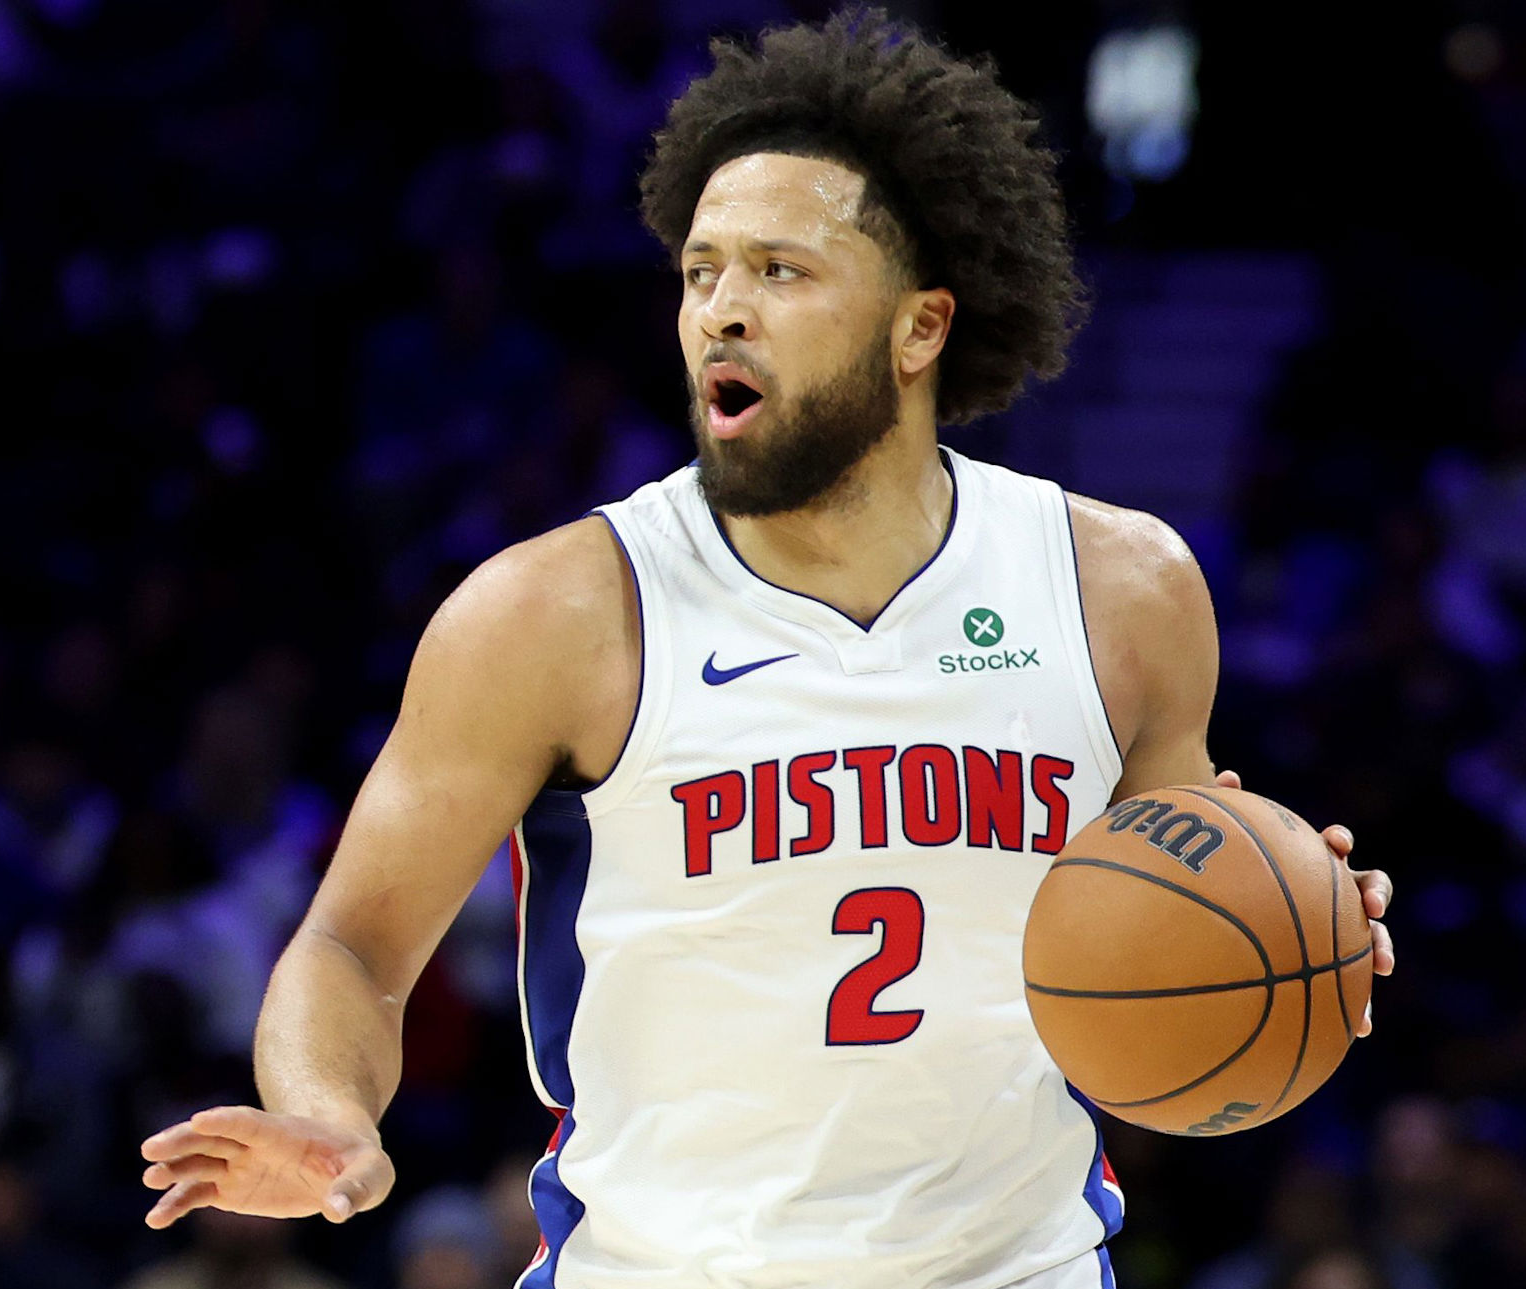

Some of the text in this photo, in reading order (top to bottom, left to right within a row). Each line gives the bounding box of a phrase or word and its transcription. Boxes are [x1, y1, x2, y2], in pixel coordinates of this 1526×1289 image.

[938, 648, 1041, 674] StockX
[671, 744, 1075, 878] PISTONS
[825, 887, 925, 1047] 2
